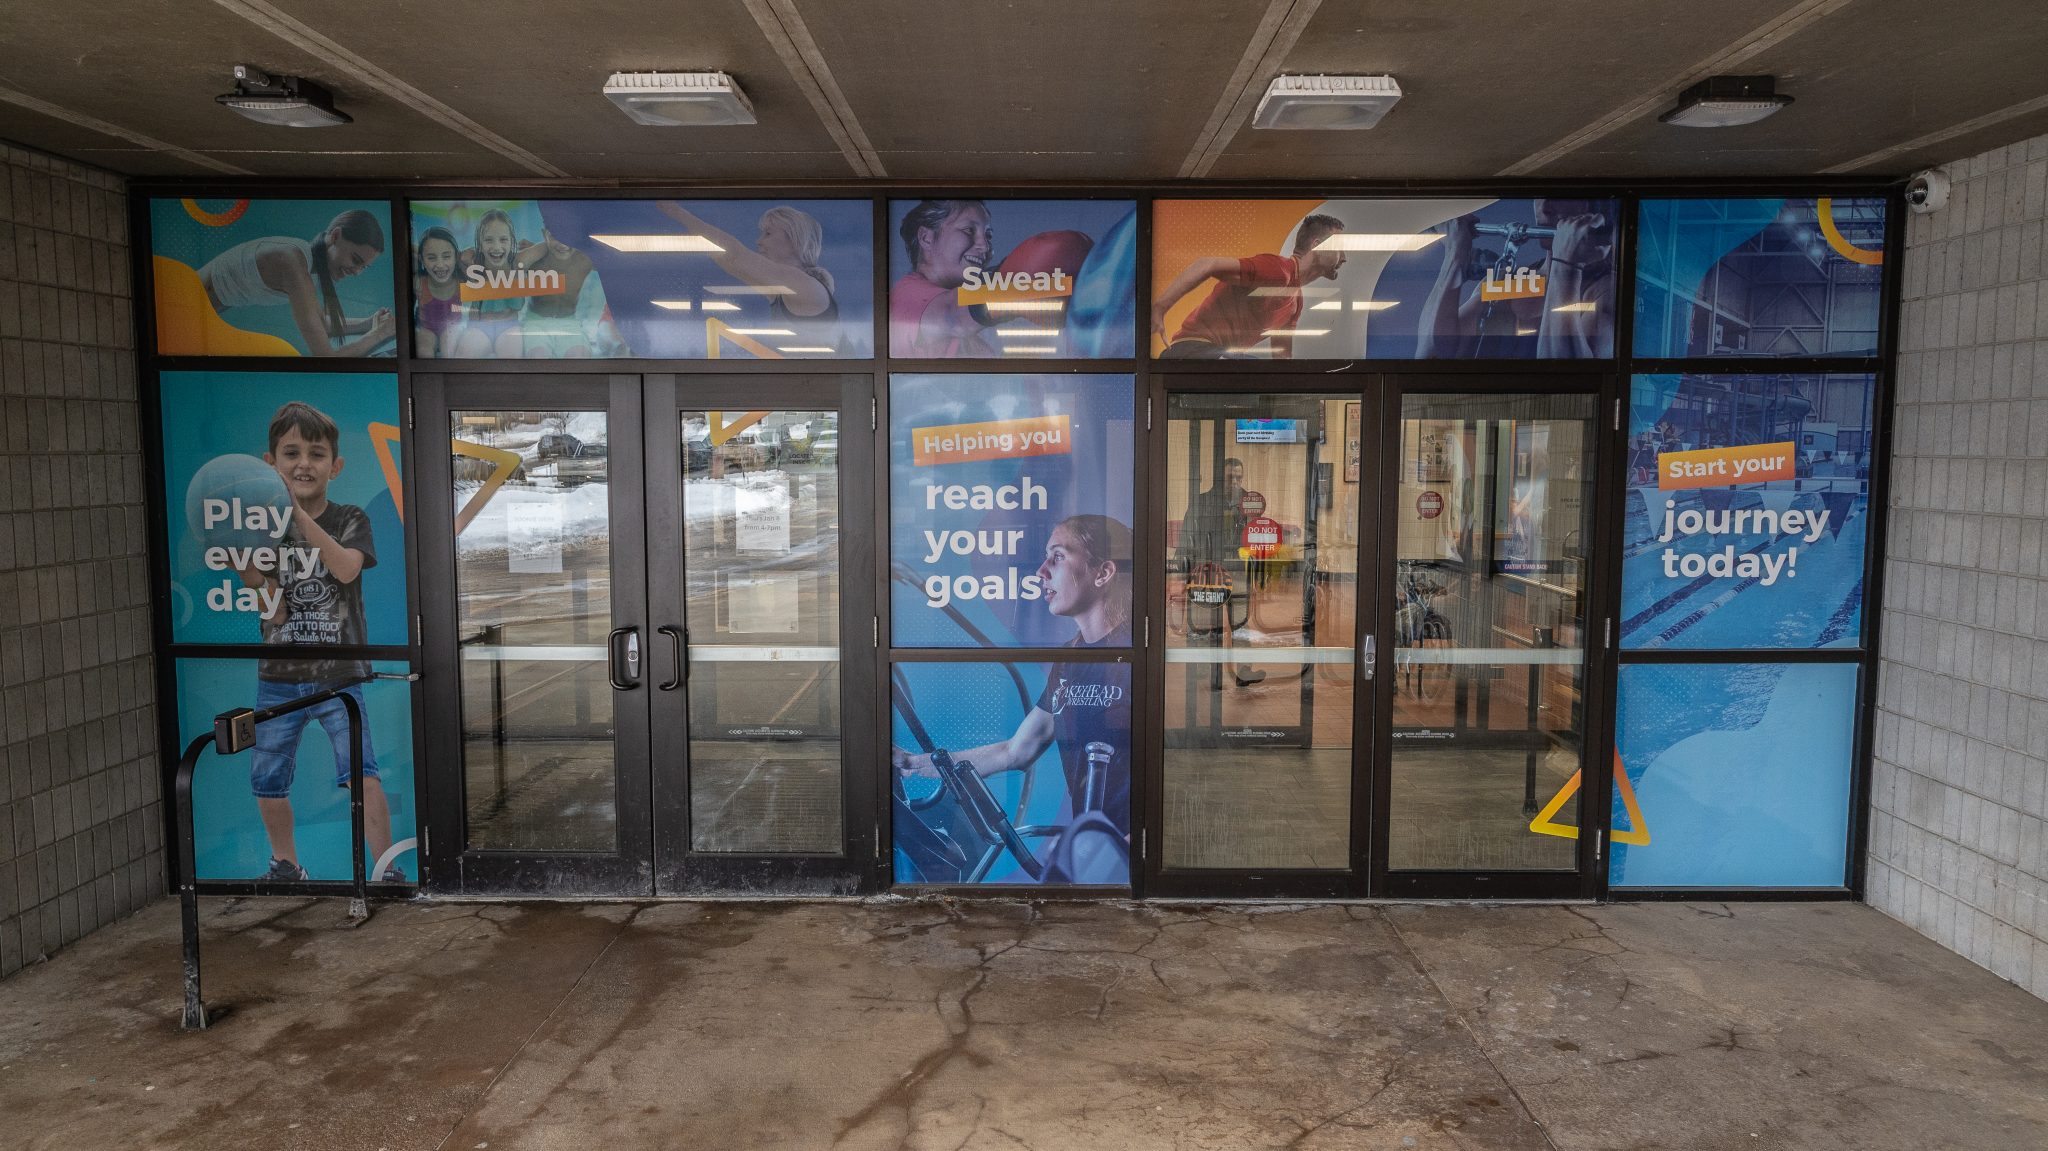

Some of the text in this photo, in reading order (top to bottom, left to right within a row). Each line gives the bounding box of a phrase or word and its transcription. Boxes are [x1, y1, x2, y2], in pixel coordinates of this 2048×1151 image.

[466, 262, 559, 289] Swim
[961, 266, 1066, 291] Sweat
[1486, 266, 1541, 293] Lift
[923, 430, 1061, 455] Helping you
[1669, 456, 1786, 479] Start your
[926, 476, 1048, 510] reach
[203, 498, 294, 538] Play
[1658, 499, 1831, 543] journey
[923, 530, 1024, 564] your
[204, 546, 320, 579] every
[1661, 545, 1797, 586] today!
[206, 579, 284, 620] day
[299, 584, 319, 595] 1981
[925, 567, 1042, 608] goals
[280, 621, 305, 633] ABOUT
[305, 621, 318, 631] TO
[304, 611, 330, 621] THOSE
[294, 631, 320, 642] Salute
